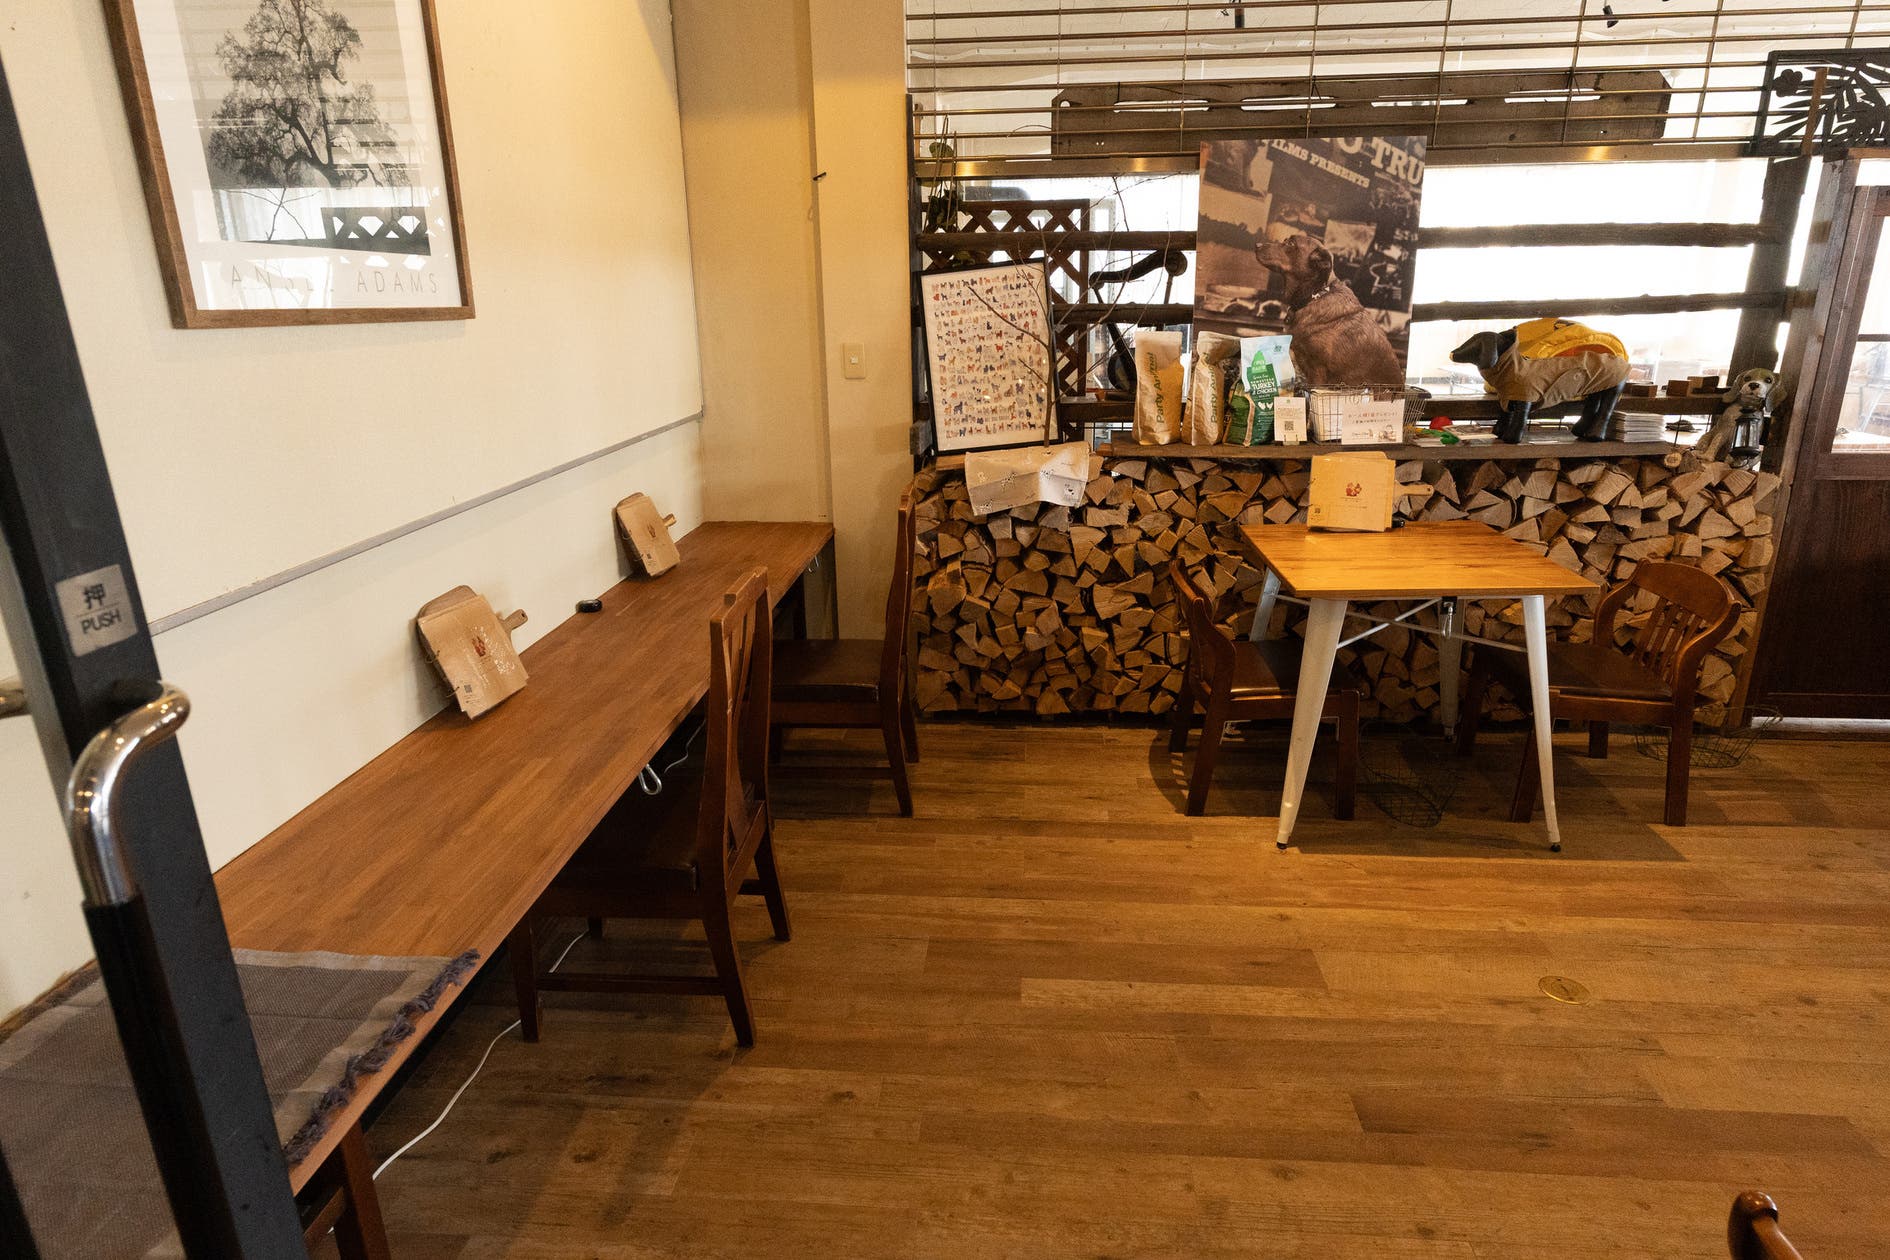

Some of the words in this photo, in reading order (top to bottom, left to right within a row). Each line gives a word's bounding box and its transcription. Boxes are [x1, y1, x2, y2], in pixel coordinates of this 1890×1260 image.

[1310, 150, 1371, 189] PRESENTS
[1370, 137, 1424, 185] TRU
[357, 271, 440, 294] ADAMS
[1146, 352, 1162, 391] Animal
[1252, 382, 1275, 391] TURKEY
[1154, 393, 1165, 424] Party
[83, 583, 106, 610] 押
[81, 609, 121, 634] PUSH
